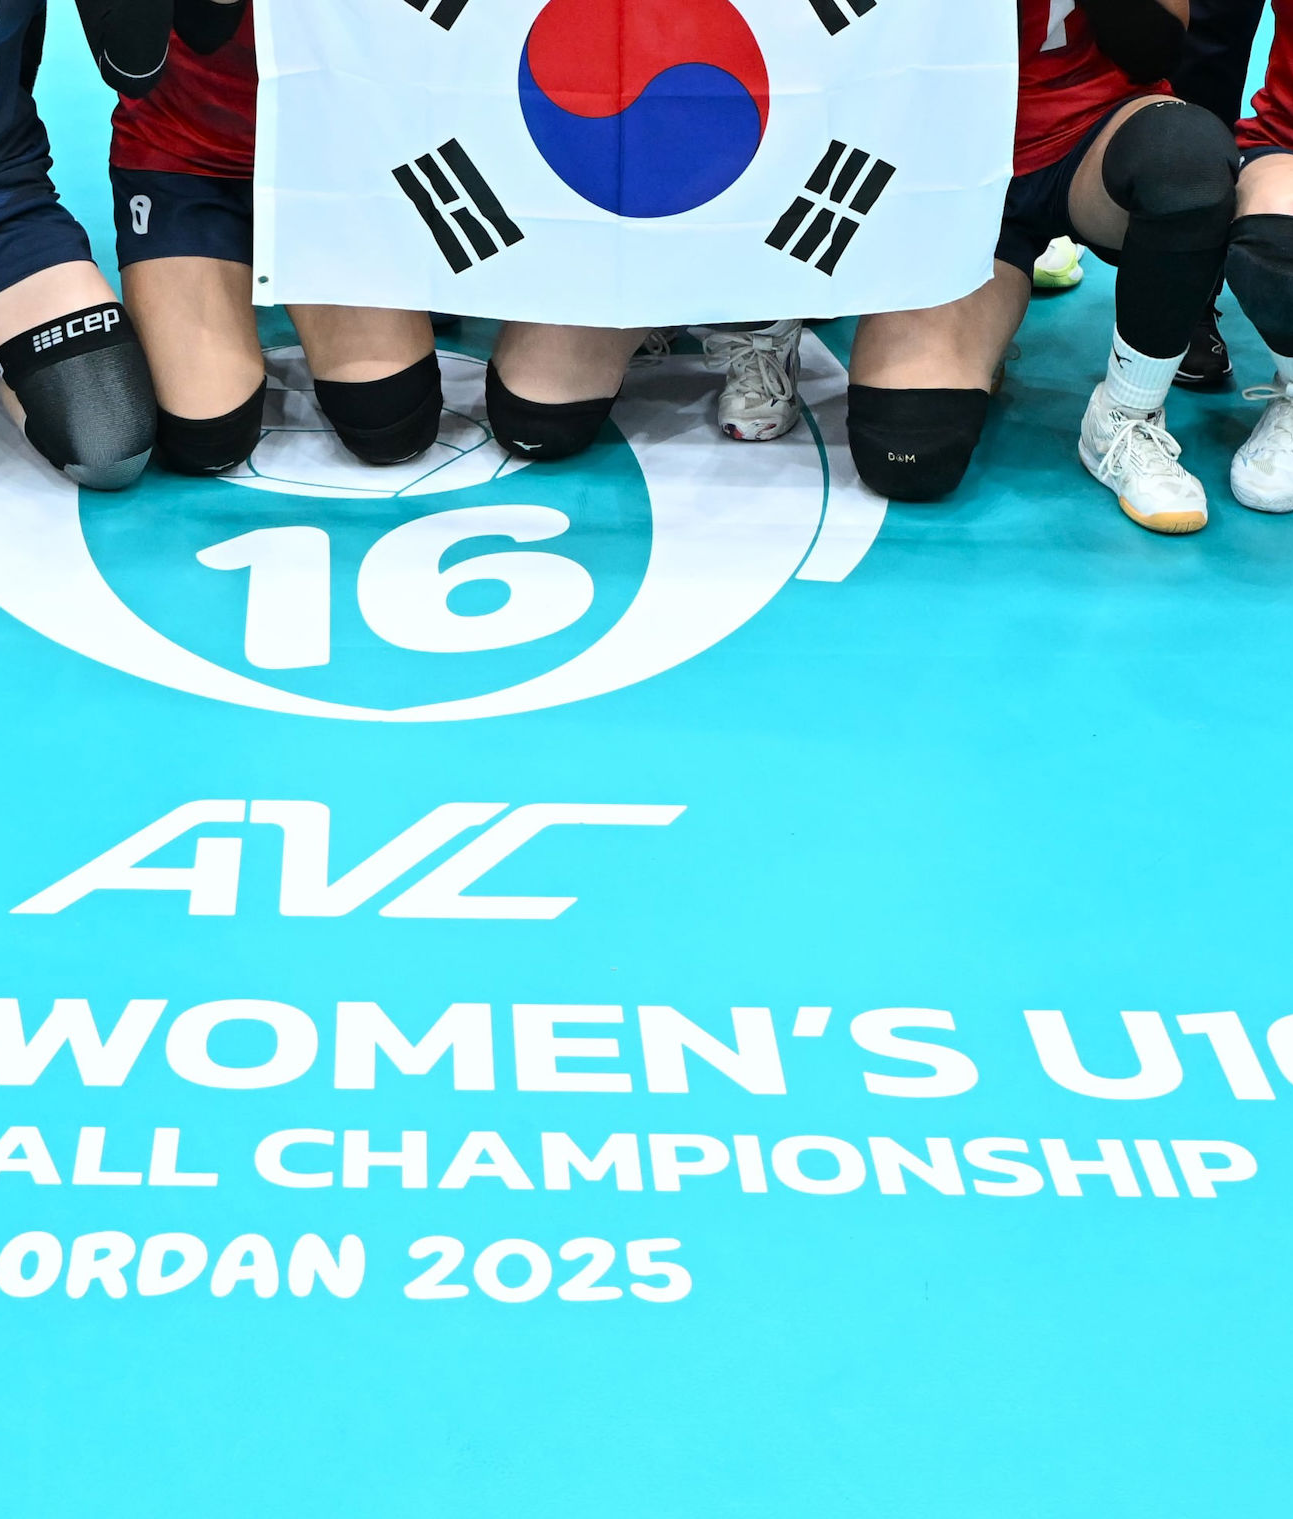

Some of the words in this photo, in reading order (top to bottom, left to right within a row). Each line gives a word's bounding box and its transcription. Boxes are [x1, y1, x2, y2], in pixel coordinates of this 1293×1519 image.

[66, 308, 120, 338] cep
[196, 504, 594, 669] 16
[10, 800, 687, 919] AVC
[255, 1129, 1257, 1198] CHAMPIONSHIP
[404, 1236, 692, 1303] 2025
